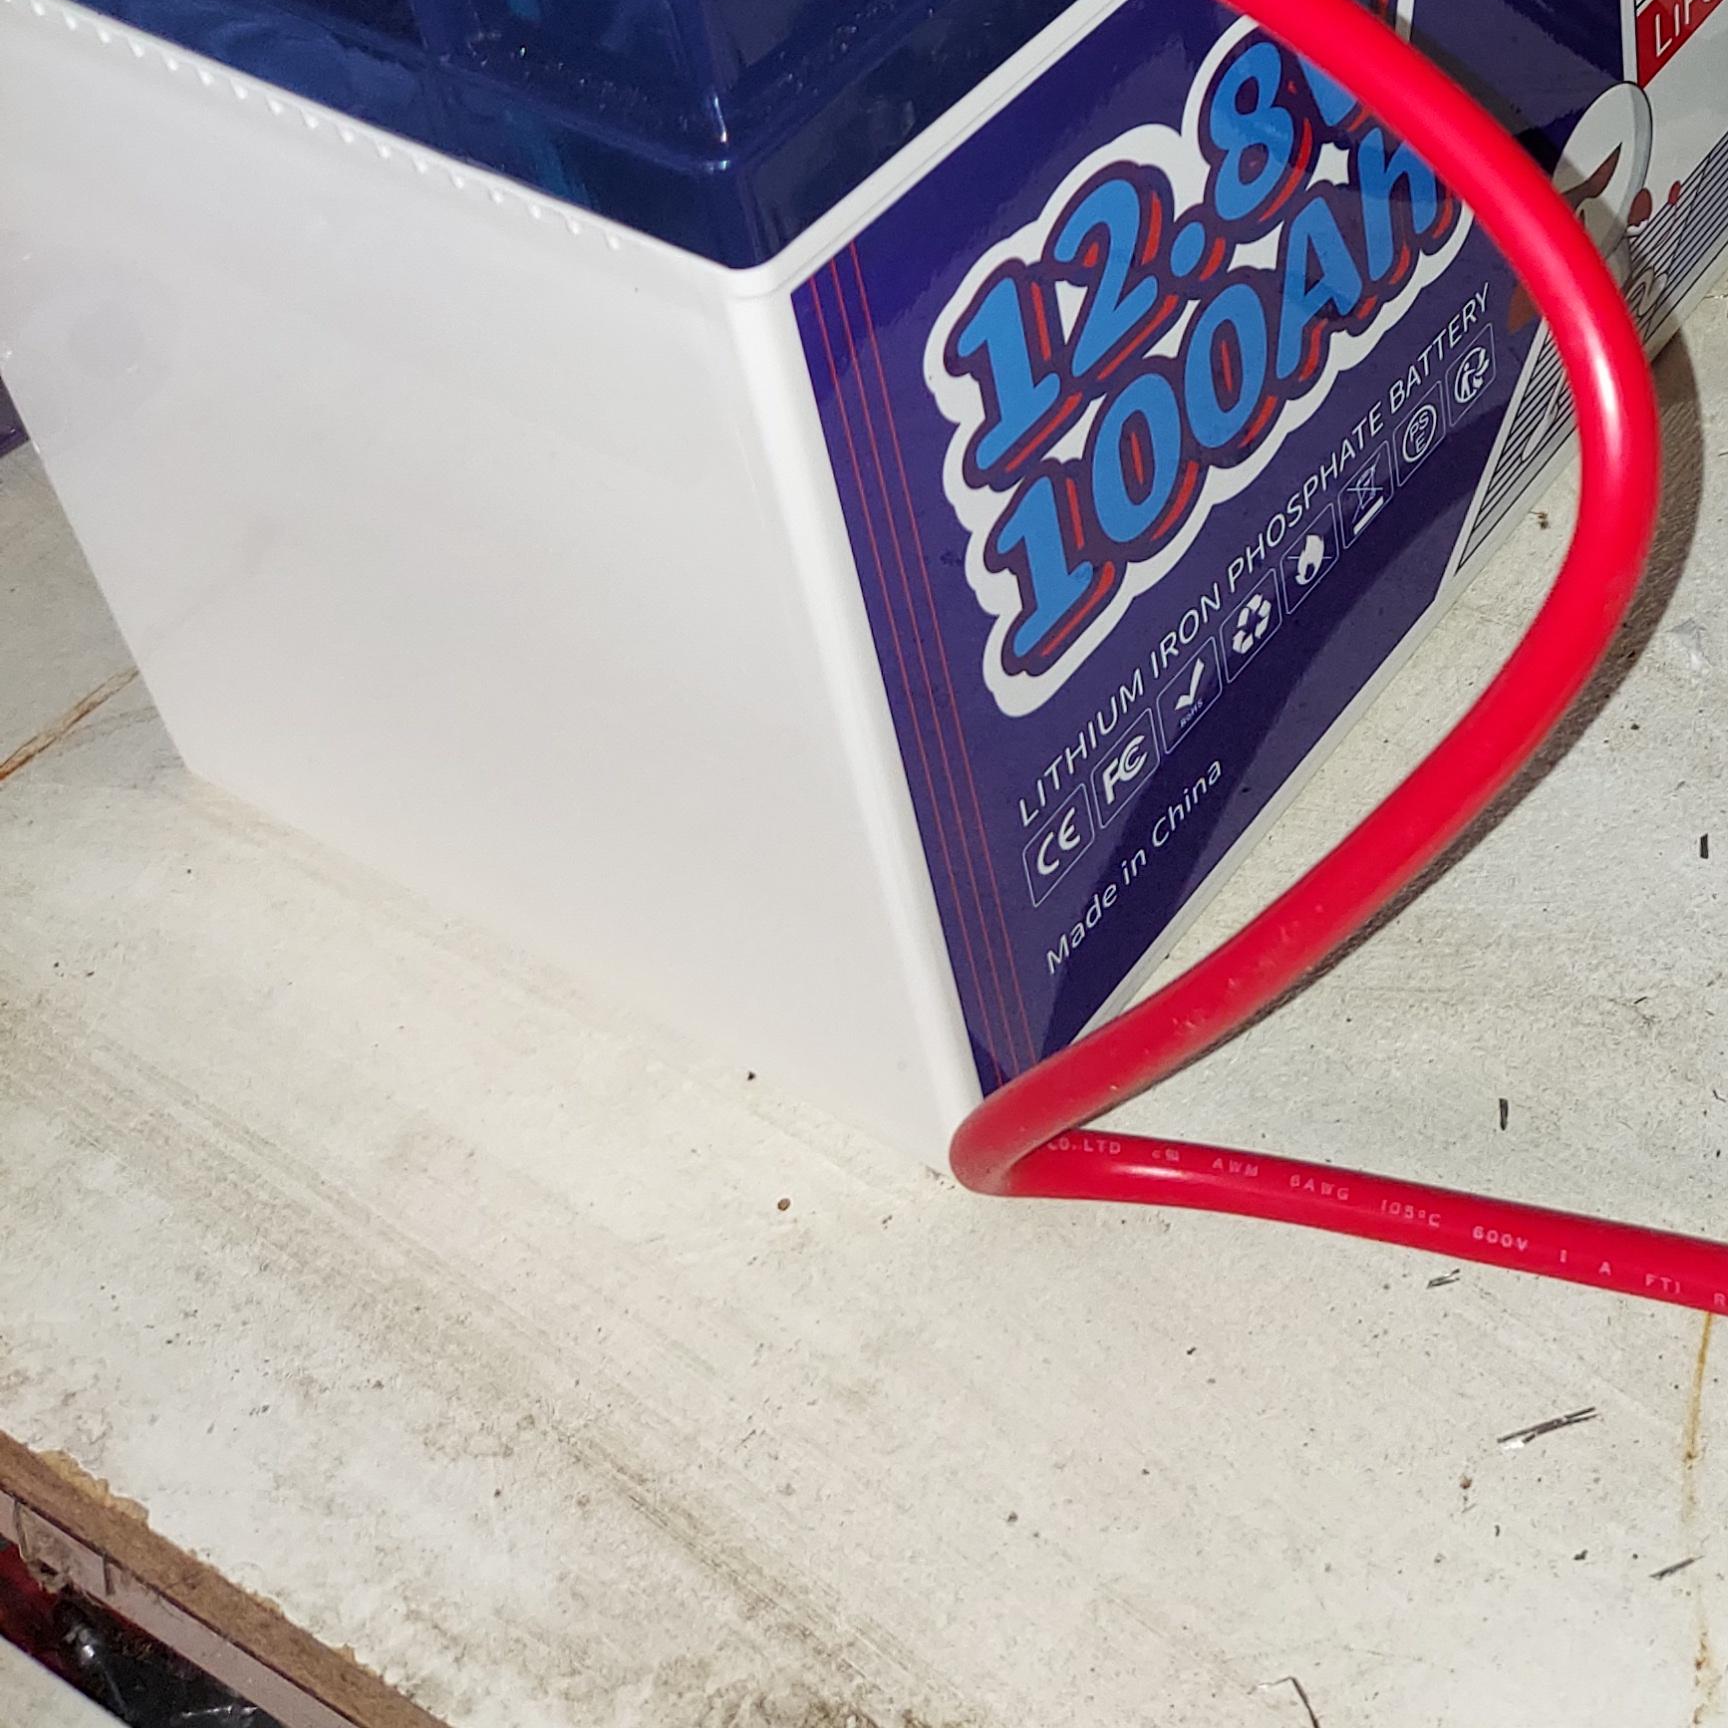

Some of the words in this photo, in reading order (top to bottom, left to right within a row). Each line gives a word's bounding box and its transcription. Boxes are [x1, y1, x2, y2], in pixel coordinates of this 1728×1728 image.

[992, 125, 1450, 664] 100Ah
[1018, 670, 1145, 827] LITHIUM
[1150, 582, 1222, 680] IRON
[1226, 401, 1385, 594] PHOSPHATE
[1388, 281, 1491, 415] BATTERY
[1036, 806, 1082, 876] CE
[1045, 882, 1118, 974] Made
[1121, 846, 1147, 886] in
[1151, 759, 1223, 849] China
[1211, 1157, 1260, 1178] AWM
[1288, 1174, 1351, 1201] 6AWG
[1471, 1225, 1530, 1253] 600V
